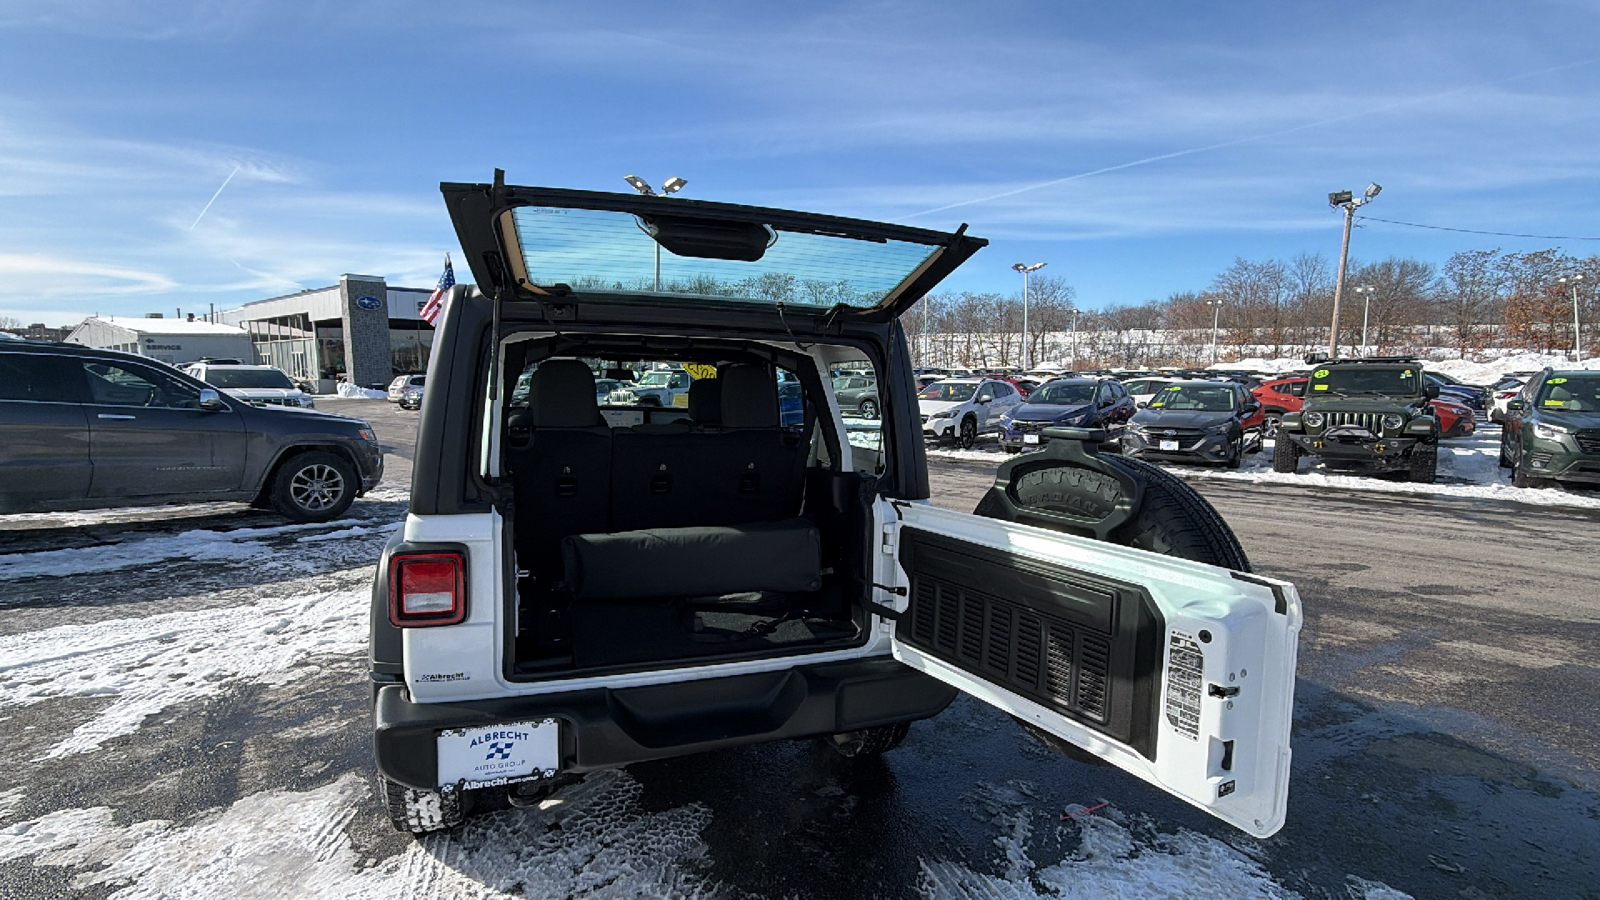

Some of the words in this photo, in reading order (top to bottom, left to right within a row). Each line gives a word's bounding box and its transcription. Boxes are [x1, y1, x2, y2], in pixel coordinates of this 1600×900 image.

[430, 672, 464, 680] Albrecht
[469, 731, 529, 749] ALBRECHT
[474, 763, 497, 772] AUTO
[499, 759, 526, 769] GROUP
[462, 776, 508, 791] Albrecht
